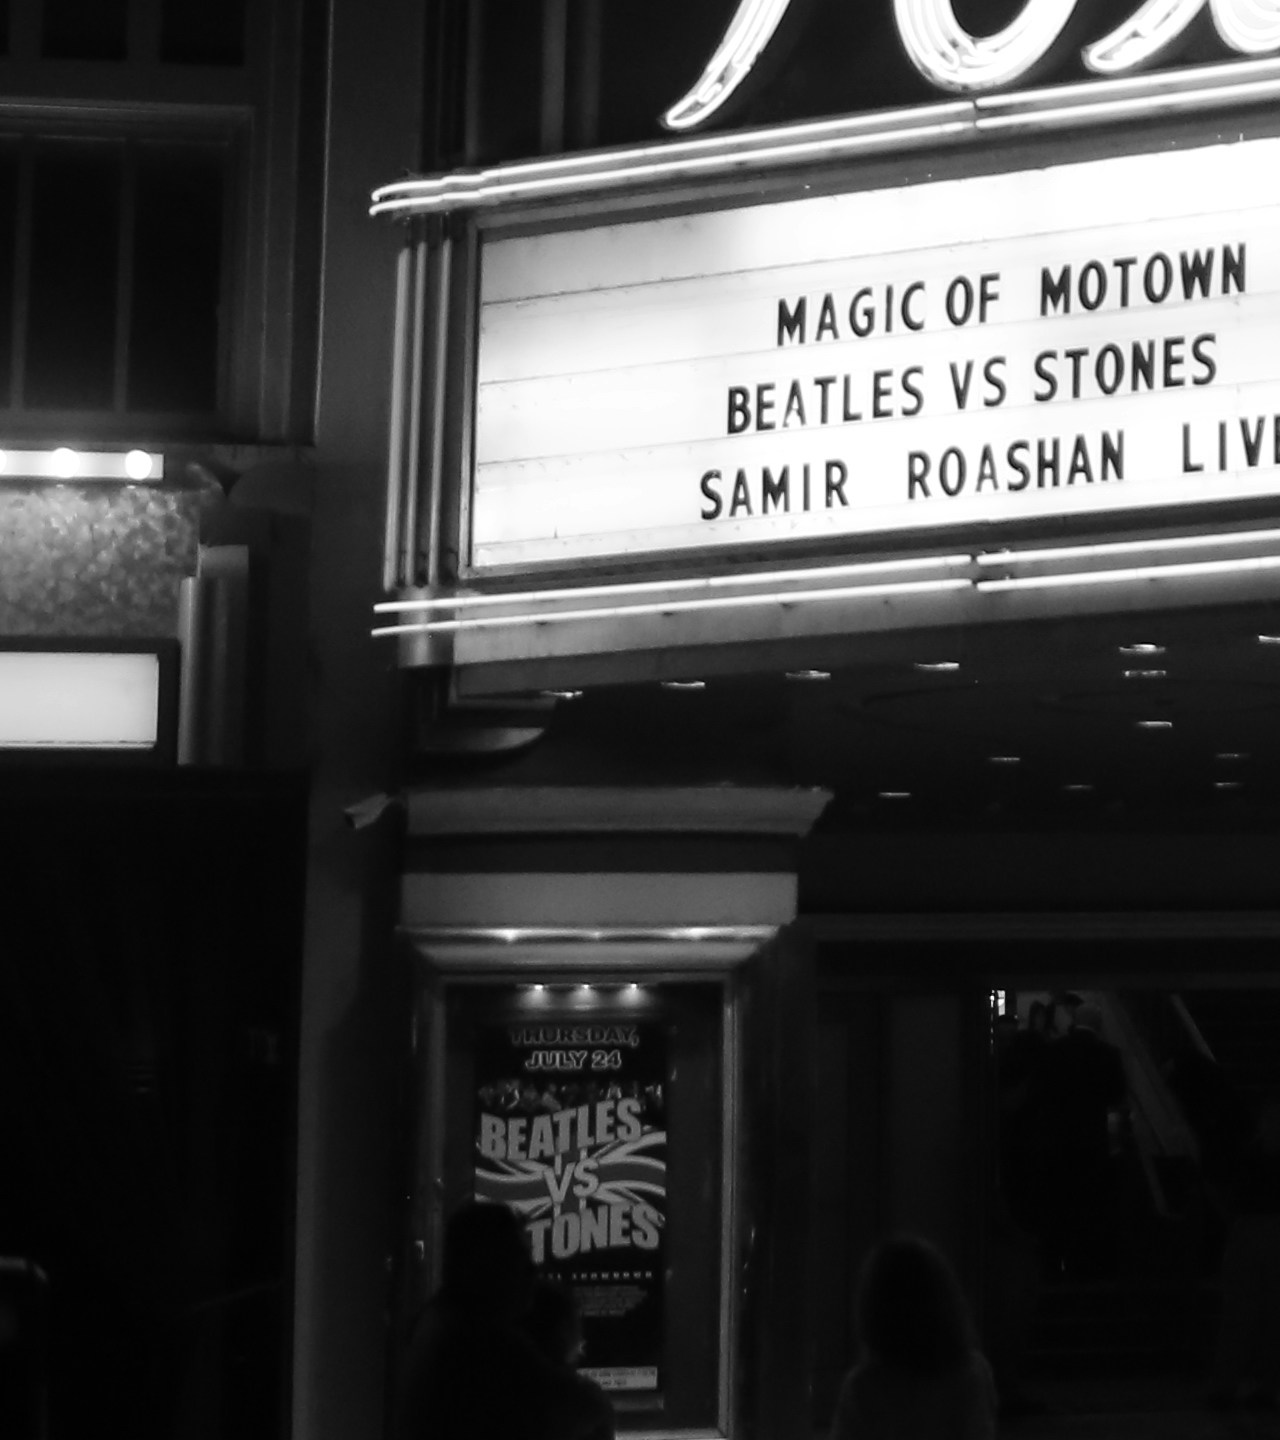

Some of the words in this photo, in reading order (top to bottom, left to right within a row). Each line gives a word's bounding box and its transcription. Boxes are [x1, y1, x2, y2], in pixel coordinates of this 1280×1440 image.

[777, 280, 926, 348] MAGIC
[944, 271, 1001, 328] OF
[1040, 241, 1247, 318] MOTOWN
[726, 365, 926, 436] BEATLES
[949, 355, 1007, 410] VS
[1033, 332, 1217, 403] STONES
[699, 459, 849, 521] SAMIR
[906, 428, 1126, 500] ROASHAN
[508, 1025, 640, 1048] THURSDAY,
[524, 1049, 588, 1071] JULY
[591, 1049, 622, 1071] 24
[479, 1097, 642, 1161] BEATLES
[541, 1157, 601, 1204] VS
[524, 1205, 660, 1264] TONES
